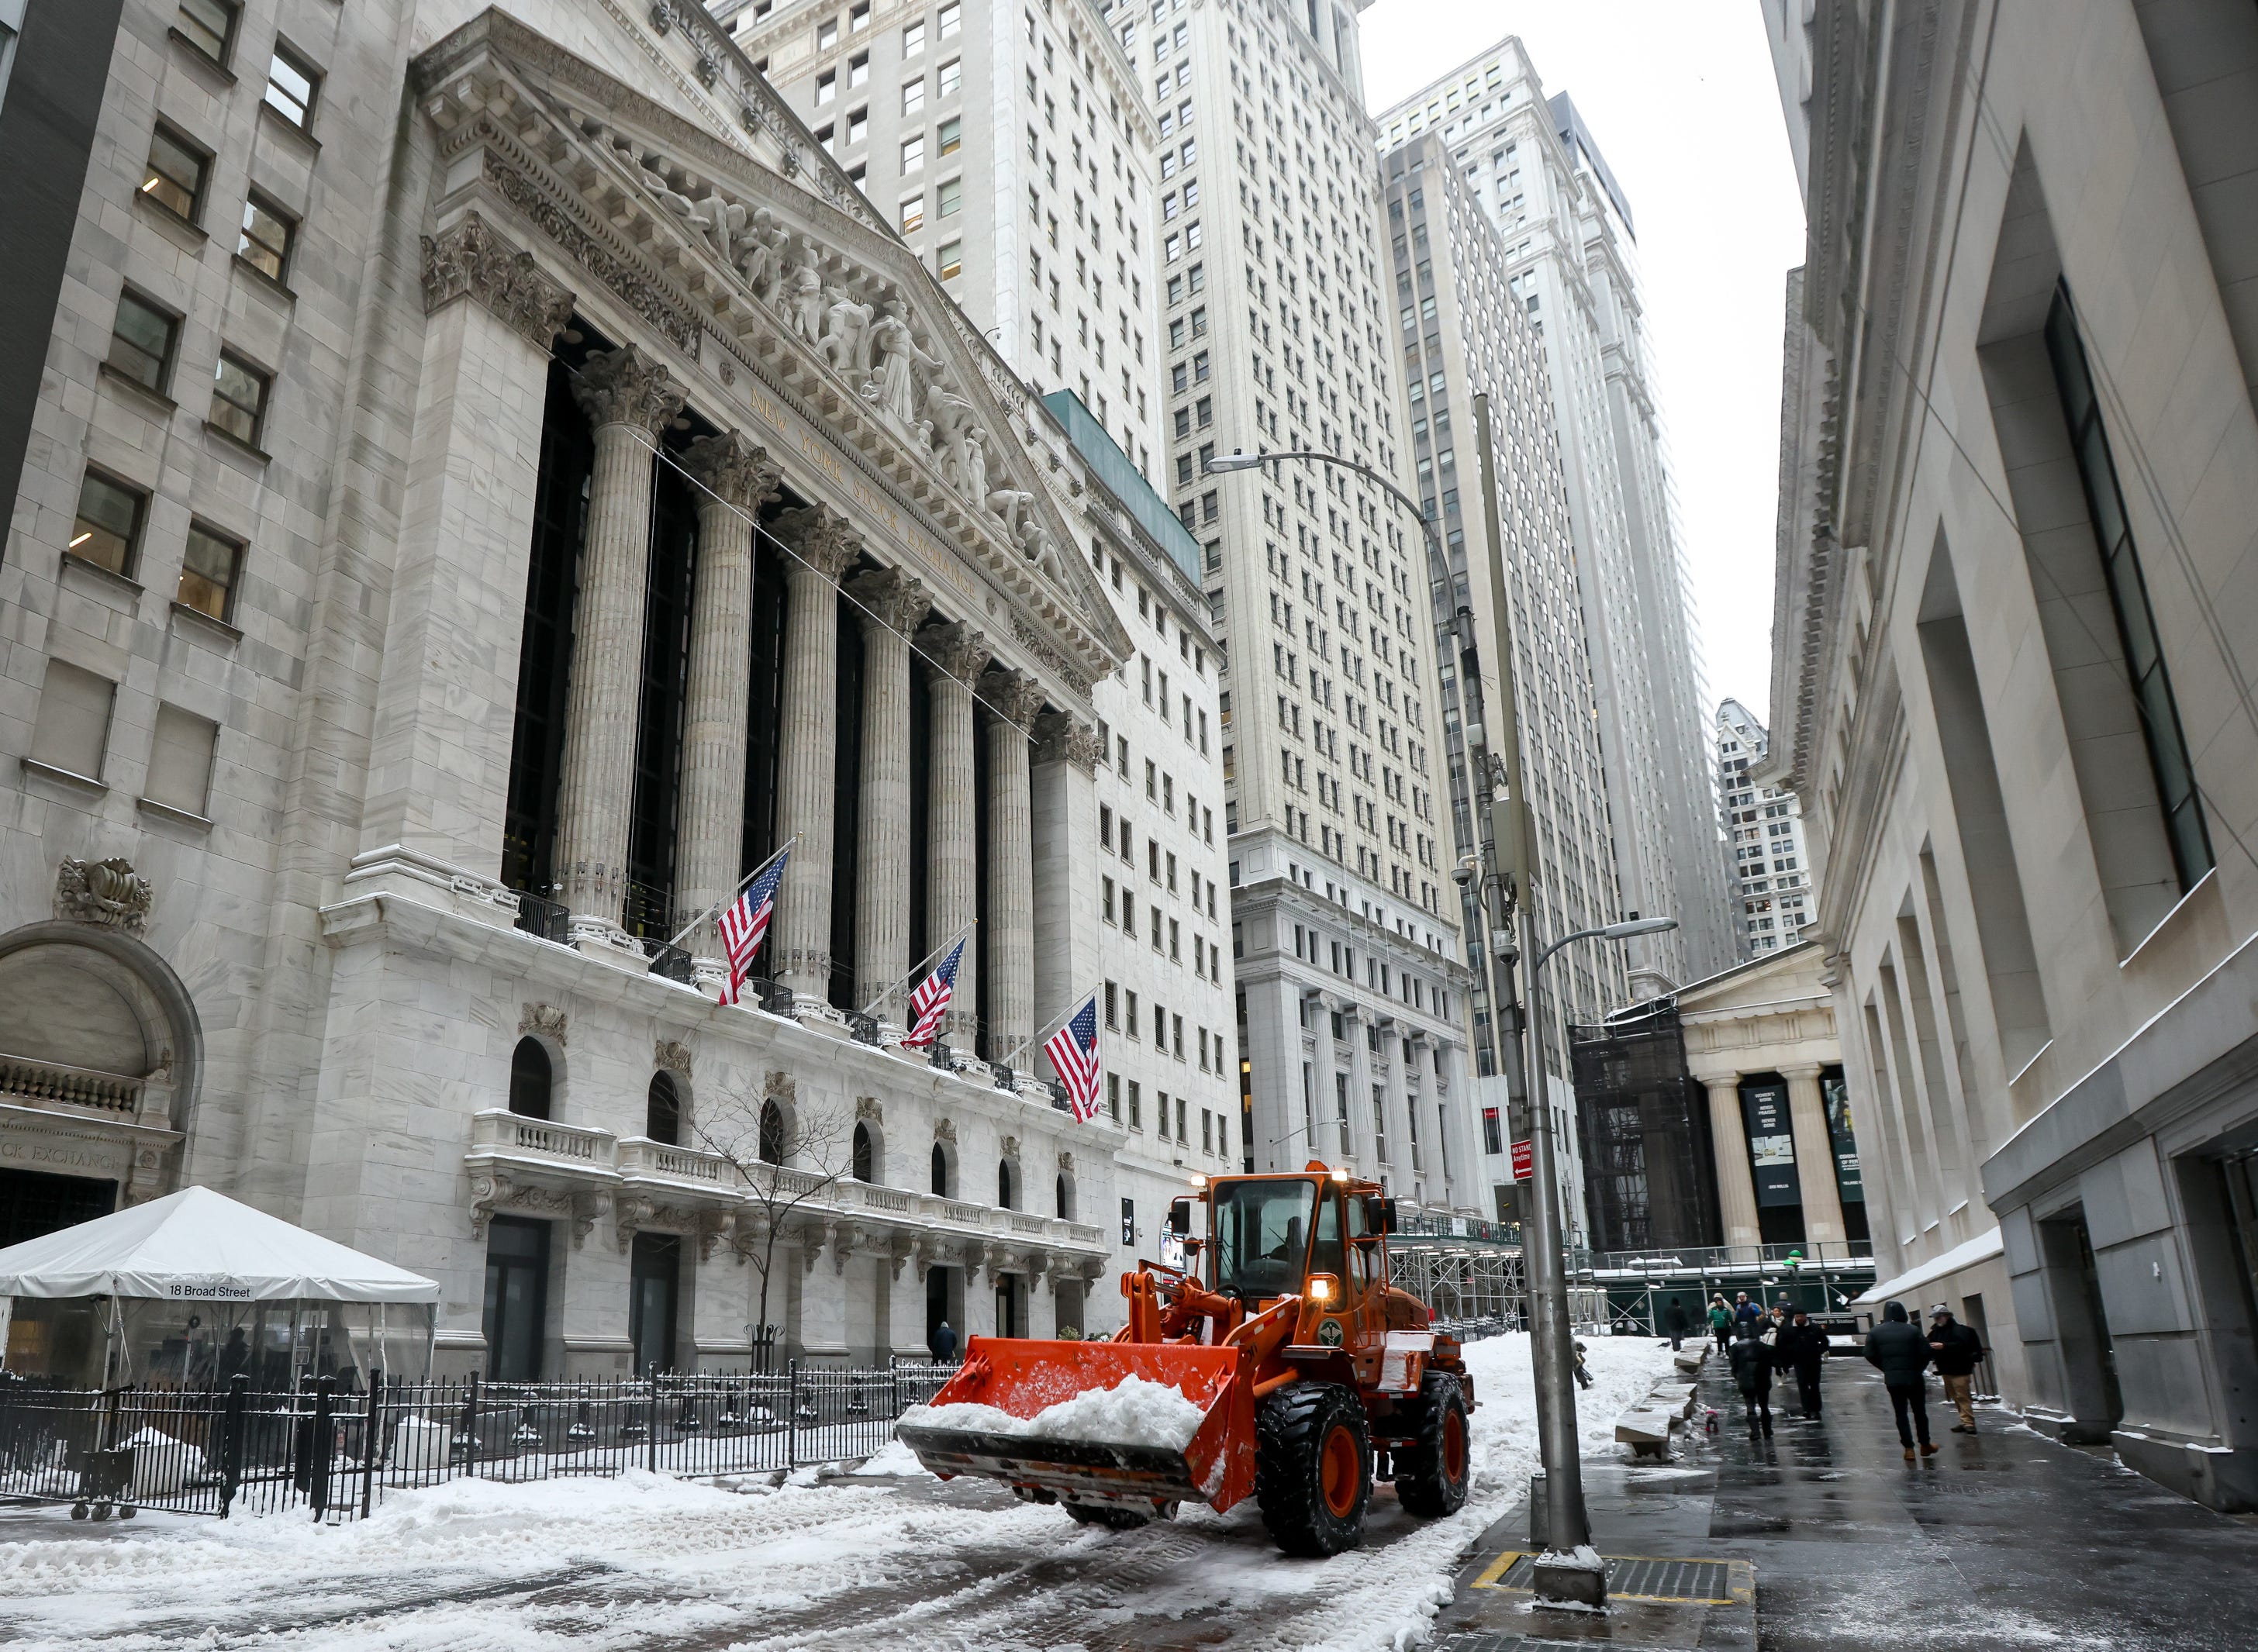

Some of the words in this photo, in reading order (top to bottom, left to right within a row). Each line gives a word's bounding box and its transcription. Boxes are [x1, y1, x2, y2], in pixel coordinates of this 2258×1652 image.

[751, 388, 788, 433] NEW
[799, 429, 844, 485] YORK
[854, 479, 899, 534] STOCK
[907, 526, 975, 600] EXCHANGE
[1514, 1154, 1530, 1162] Anytime
[170, 1285, 181, 1295] 18
[185, 1285, 216, 1297] Broad
[218, 1287, 250, 1298] Street
